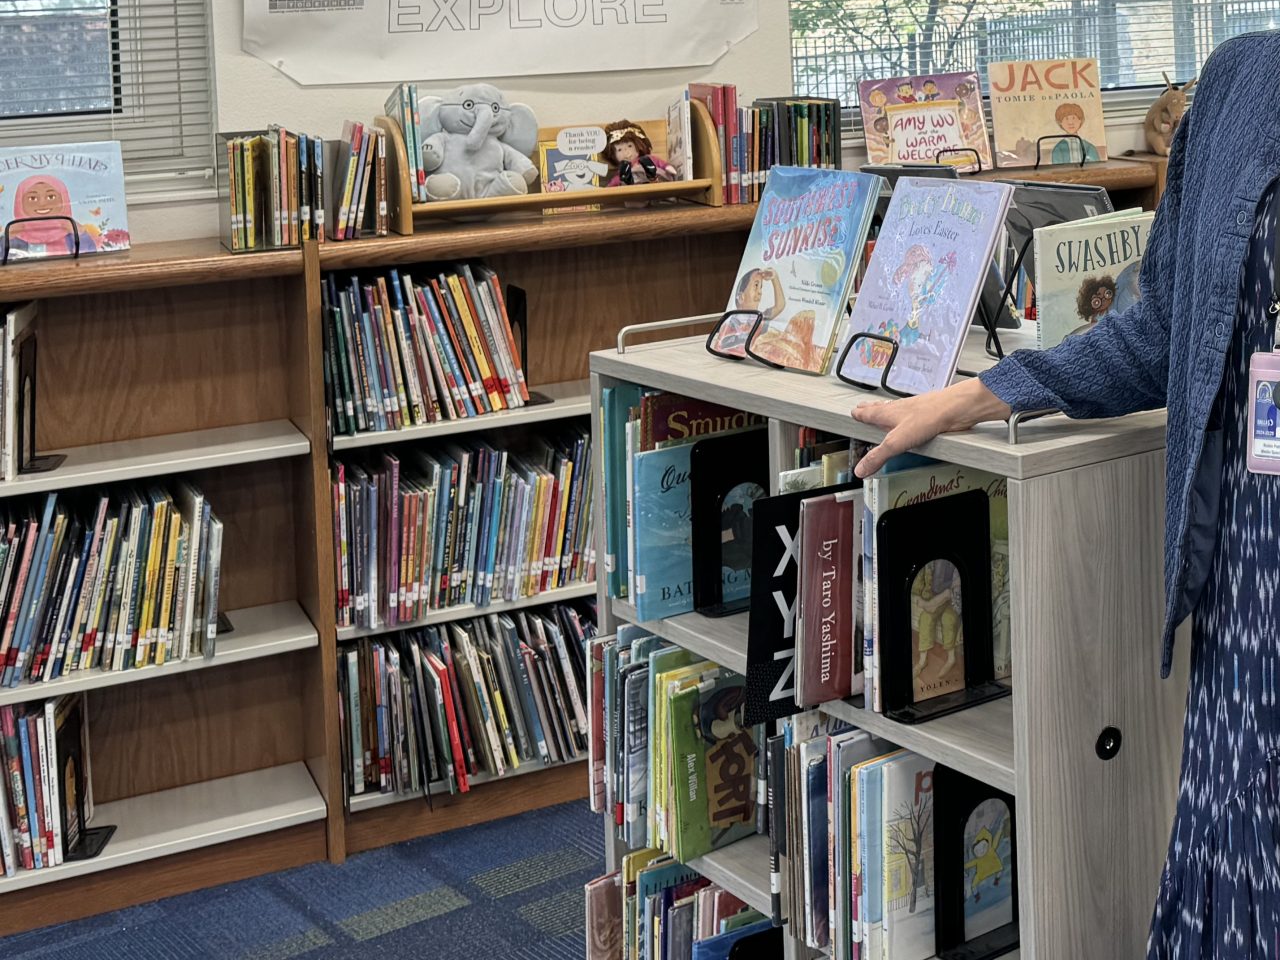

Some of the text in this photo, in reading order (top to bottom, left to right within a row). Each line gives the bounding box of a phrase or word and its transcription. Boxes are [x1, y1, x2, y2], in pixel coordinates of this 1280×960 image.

[992, 61, 1096, 93] JACK
[995, 94, 1036, 103] TOMIE
[893, 113, 955, 131] AMY WU
[905, 134, 947, 147] WARM
[897, 143, 960, 161] WELCOME
[763, 181, 859, 226] SOUTHWEST
[763, 216, 843, 262] SUNRISE
[909, 220, 960, 241] Loves Easter
[1055, 225, 1142, 274] SWASHBY
[894, 470, 964, 508] Grandma's
[773, 524, 800, 578] X
[772, 590, 797, 639] Y
[818, 539, 838, 684] by Taro Yashima
[769, 648, 796, 702] Z
[920, 679, 951, 692] YOLEN
[686, 753, 697, 774] Alex
[709, 730, 759, 823] FORT
